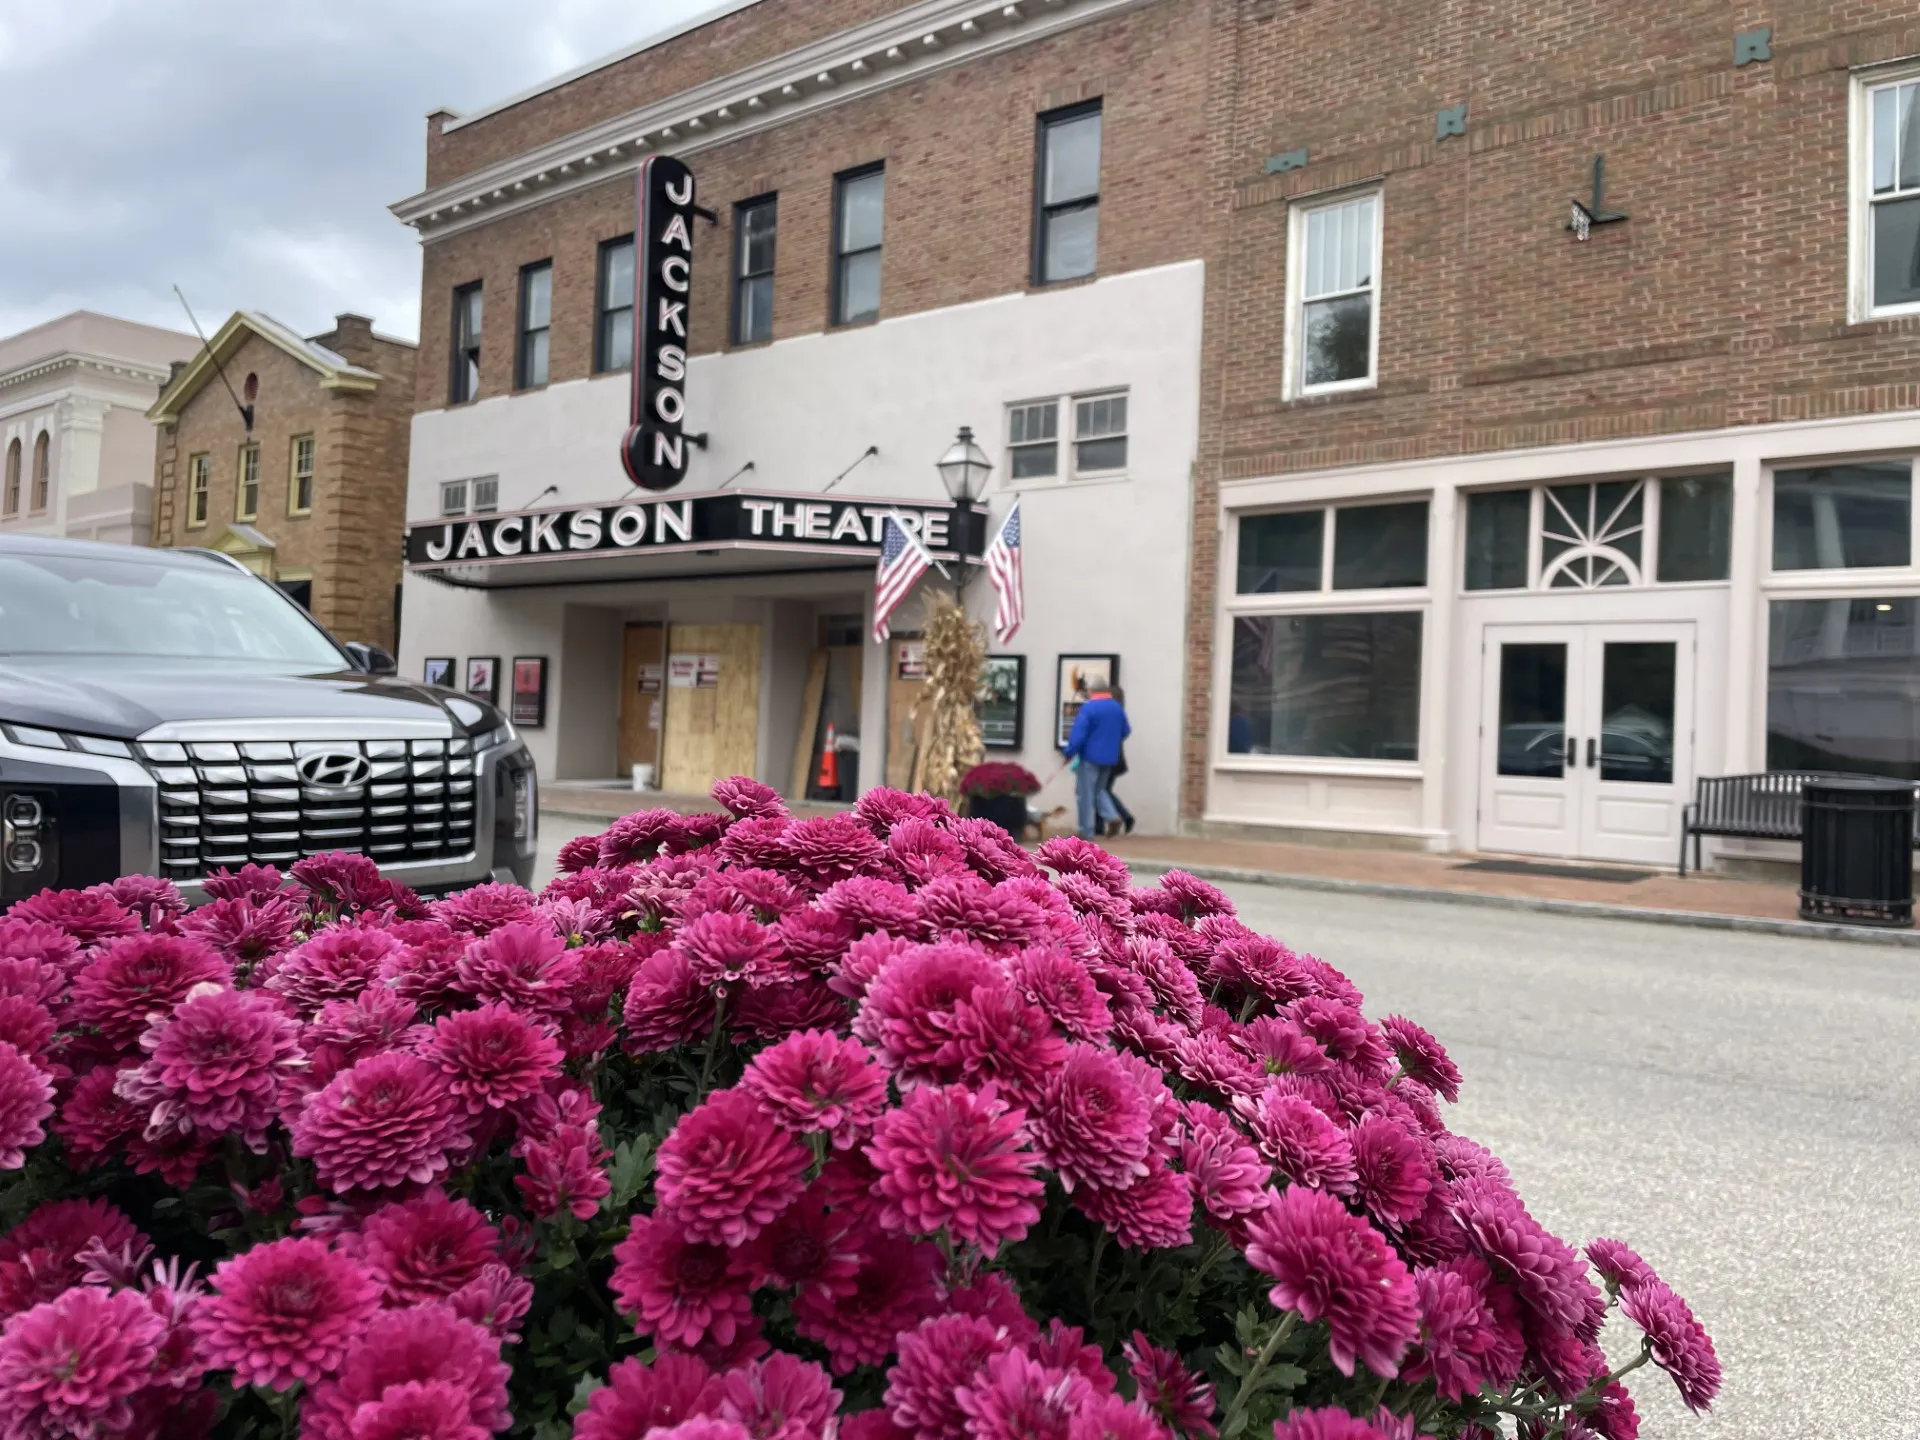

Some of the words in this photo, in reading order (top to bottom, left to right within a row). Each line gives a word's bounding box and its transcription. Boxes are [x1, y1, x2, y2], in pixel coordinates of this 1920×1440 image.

[653, 174, 693, 469] JACKSON
[425, 501, 692, 561] JACKSON
[741, 500, 950, 546] THEATRE
